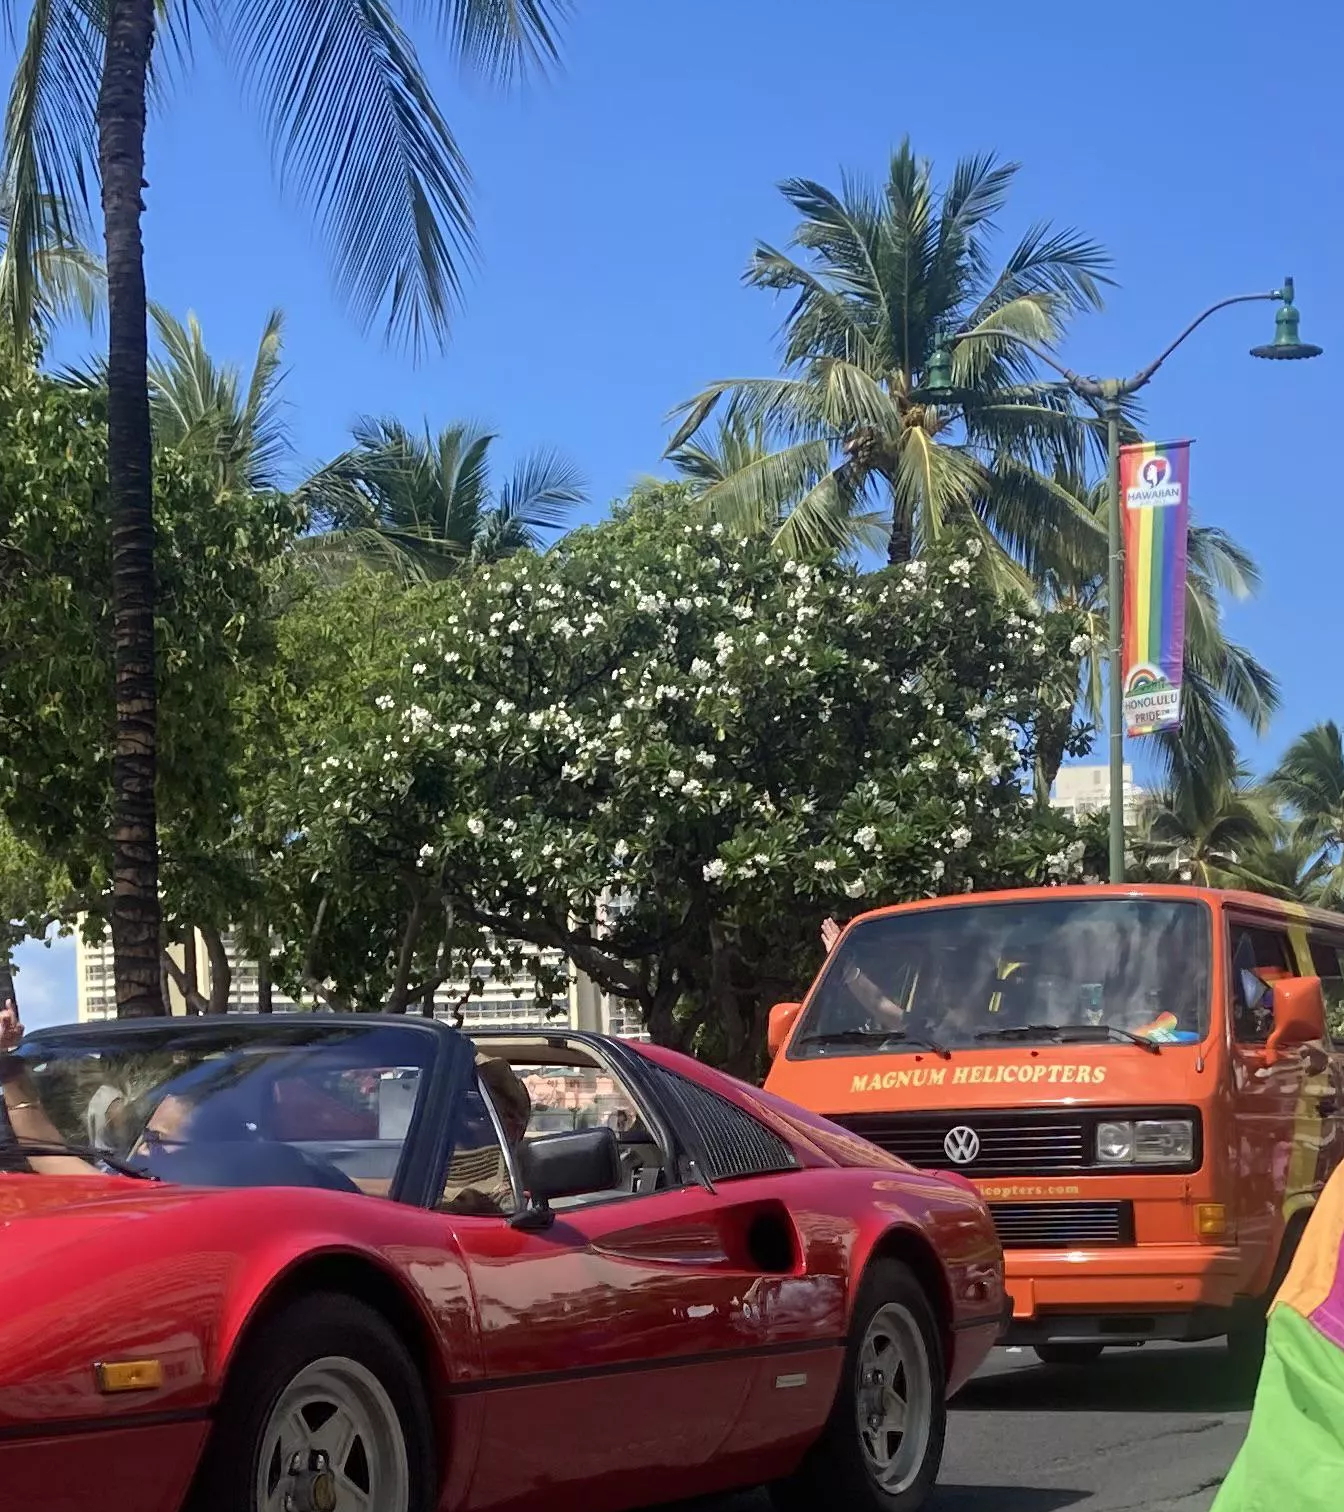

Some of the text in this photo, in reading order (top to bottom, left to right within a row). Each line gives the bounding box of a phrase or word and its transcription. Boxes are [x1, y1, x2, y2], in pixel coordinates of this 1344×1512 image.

[1125, 693, 1177, 710] HONOLULU
[850, 1065, 1106, 1092] MAGNUM HELICOPTERS
[977, 1184, 1079, 1198] icopters.com
